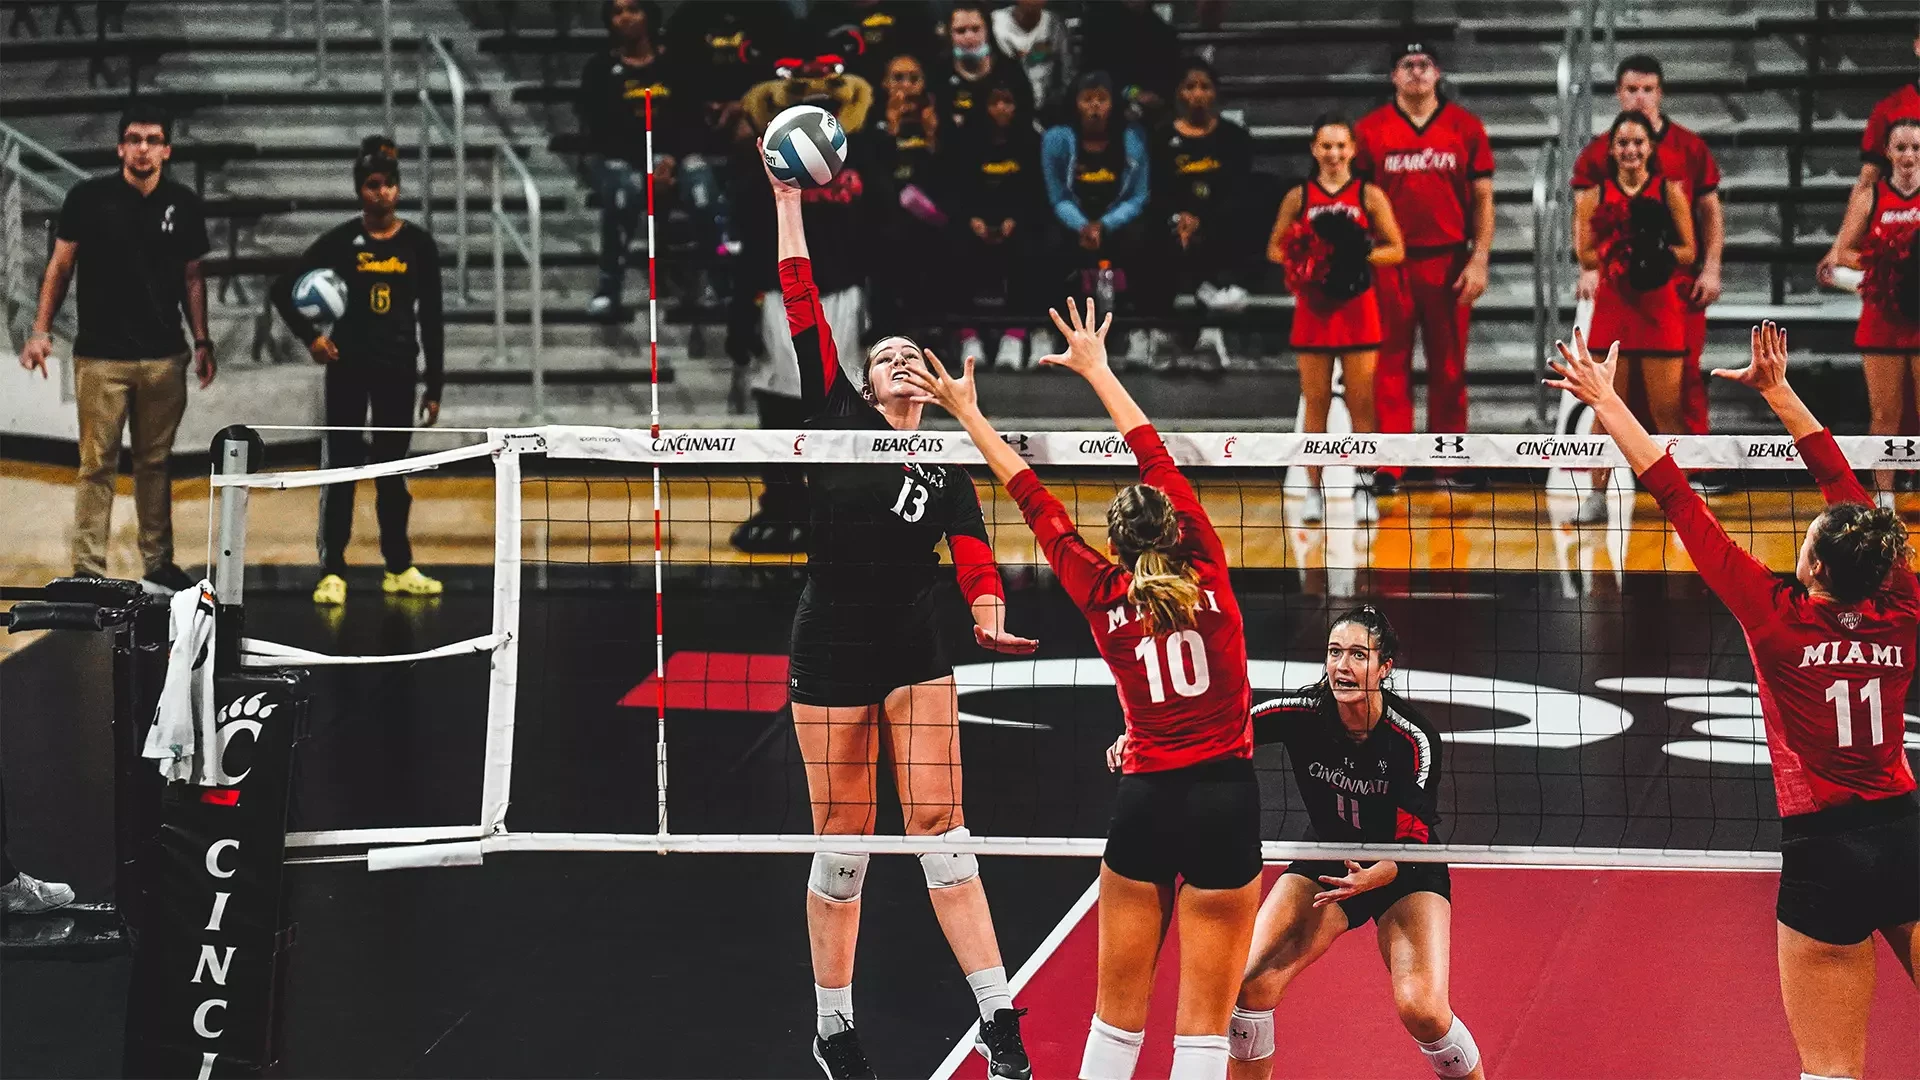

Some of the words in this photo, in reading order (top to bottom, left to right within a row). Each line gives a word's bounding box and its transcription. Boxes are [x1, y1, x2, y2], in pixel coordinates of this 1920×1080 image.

[651, 435, 736, 453] CINCINNATI
[871, 436, 944, 454] BEARCATS
[1079, 438, 1133, 456] CINCIN
[1303, 438, 1377, 456] BEARCATS
[1516, 440, 1604, 458] CINCINNATI
[1747, 441, 1801, 459] BEARC
[890, 476, 928, 523] 13
[1798, 641, 1903, 668] MIAMI
[1134, 630, 1210, 703] 10
[1825, 677, 1884, 748] 11
[1308, 762, 1390, 795] CINCINNATI
[1336, 793, 1362, 829] 11
